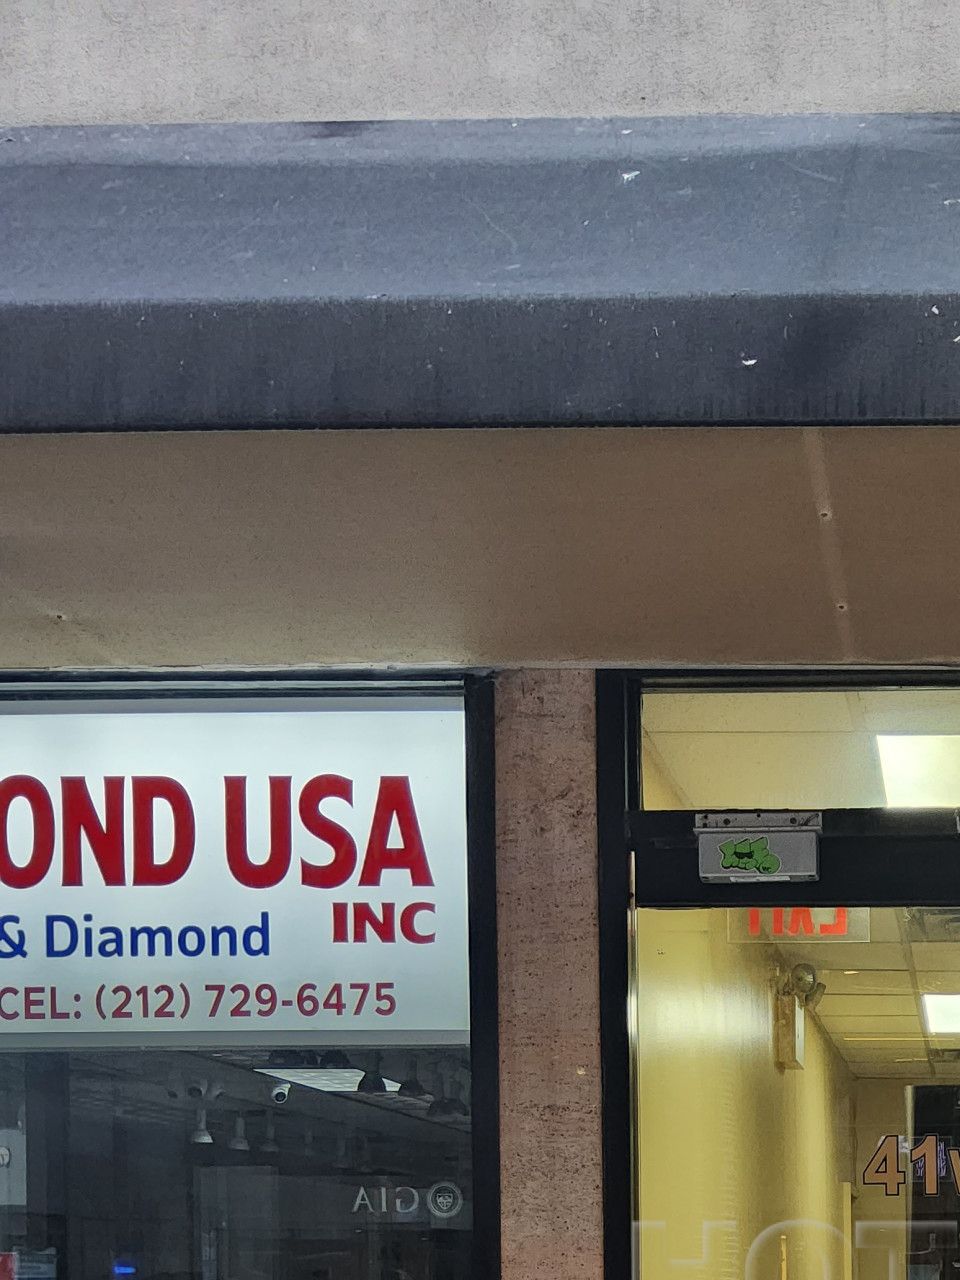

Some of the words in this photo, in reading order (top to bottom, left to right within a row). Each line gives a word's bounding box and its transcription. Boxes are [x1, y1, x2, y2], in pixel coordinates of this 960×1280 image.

[0, 774, 196, 889] OND
[223, 774, 435, 889] USA
[0, 915, 28, 958] &
[46, 911, 270, 958] Diamond
[332, 902, 436, 944] INC
[0, 986, 82, 1020] CEL:
[95, 983, 191, 1020] (212)
[204, 982, 397, 1018] 729-6475
